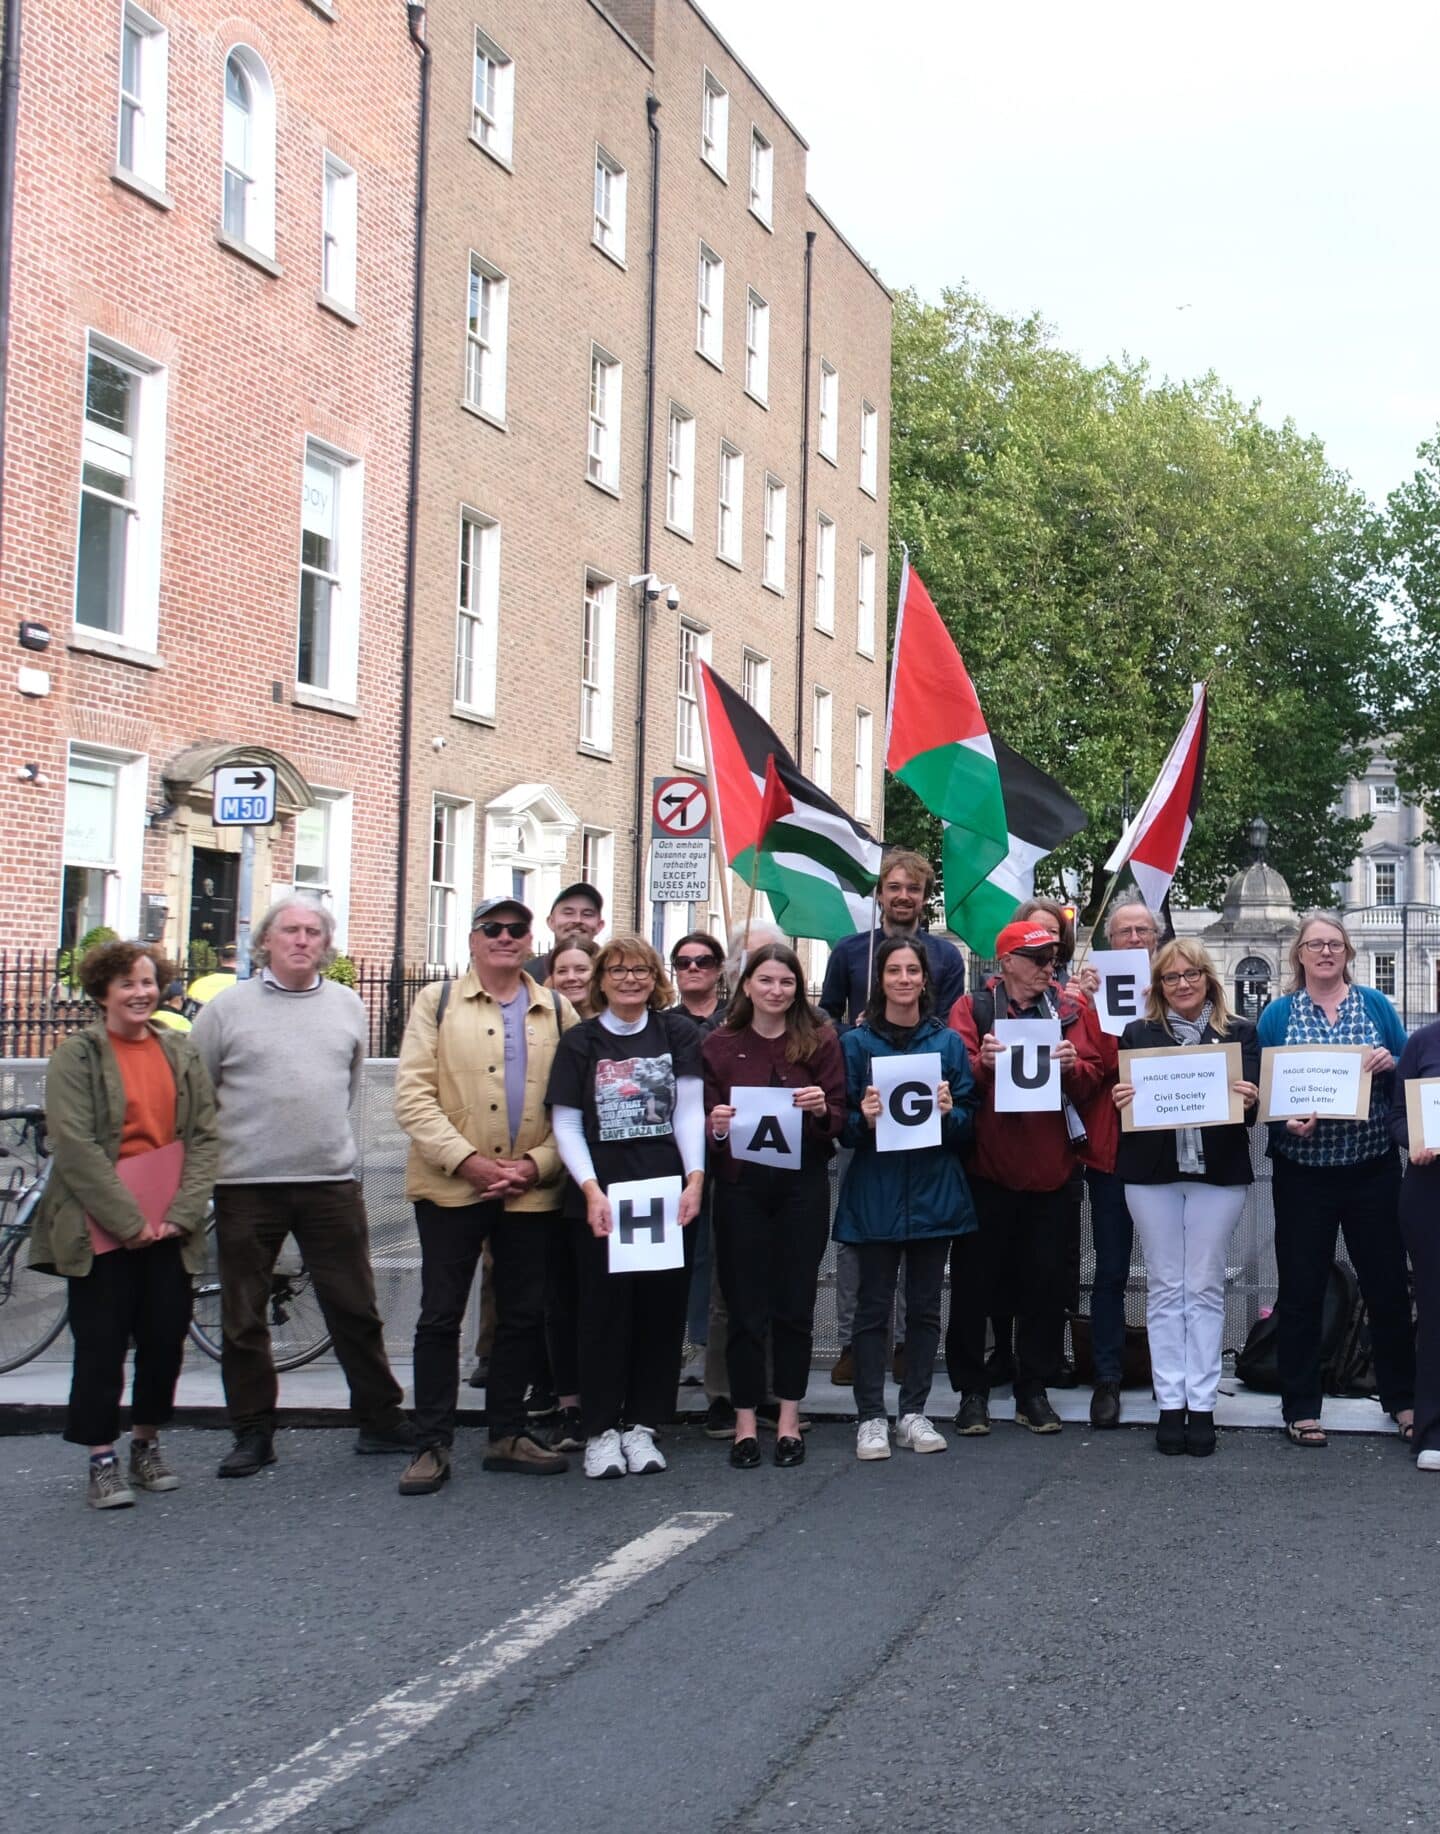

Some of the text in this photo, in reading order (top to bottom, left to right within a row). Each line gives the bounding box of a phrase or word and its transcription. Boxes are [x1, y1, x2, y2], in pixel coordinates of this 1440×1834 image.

[223, 798, 264, 819] M50
[663, 871, 697, 880] EXCEPT
[653, 881, 706, 889] BUSES AND
[658, 890, 701, 899] CYCLISTS
[1106, 975, 1137, 1017] E
[1010, 1046, 1051, 1090] U
[1283, 1067, 1304, 1075] HAGUE
[1143, 1073, 1168, 1082] HAGUE
[1170, 1072, 1196, 1080] GROUP
[1289, 1085, 1338, 1094] Civil Society
[1154, 1091, 1206, 1101] Civil Society
[1290, 1096, 1310, 1105] Open
[888, 1080, 934, 1127] G
[1156, 1103, 1205, 1113] Open Letter
[602, 1129, 625, 1140] SAVE
[628, 1127, 652, 1137] GAZA
[746, 1115, 793, 1155] A
[619, 1197, 665, 1244] H
